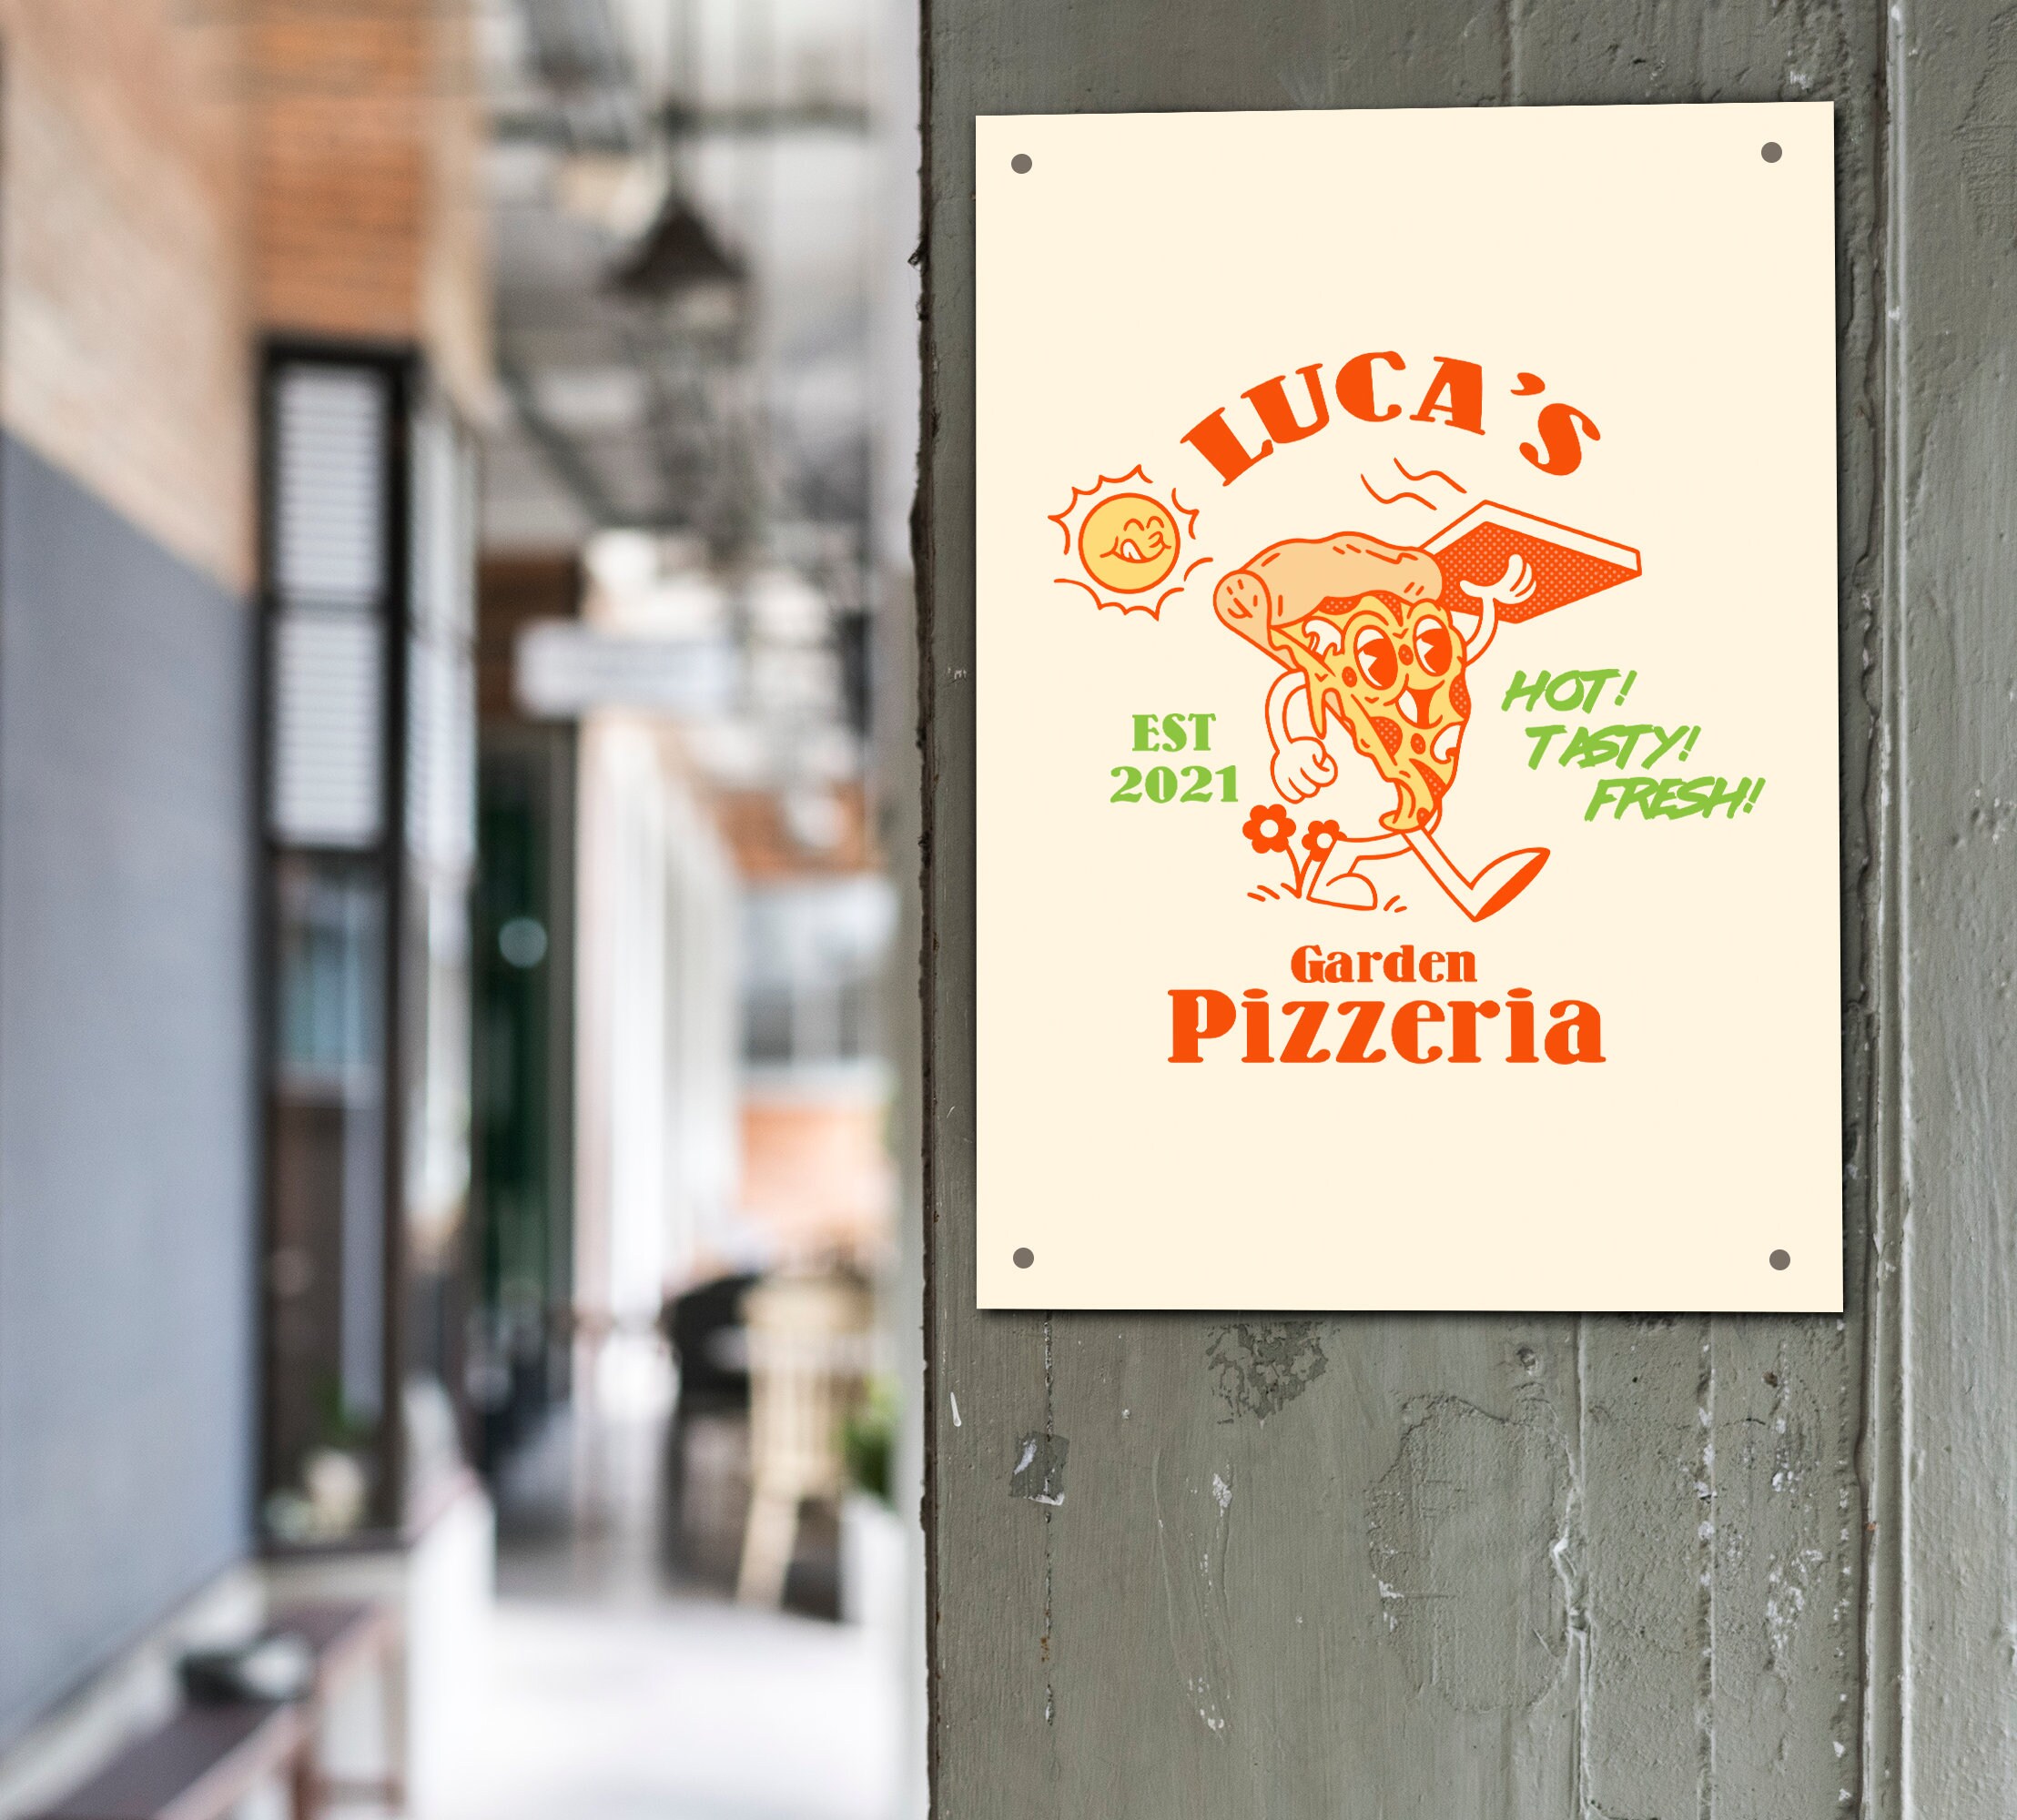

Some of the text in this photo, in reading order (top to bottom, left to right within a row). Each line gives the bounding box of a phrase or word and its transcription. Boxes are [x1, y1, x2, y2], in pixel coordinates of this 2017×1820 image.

[1181, 351, 1600, 487] LUCA'S
[1502, 669, 1637, 713] HOT!
[1132, 713, 1216, 752] EST
[1525, 724, 1701, 770] TASTY!
[1110, 765, 1238, 804] 2021
[1584, 776, 1766, 822] FRESH!
[1291, 945, 1477, 983] Garden
[1168, 987, 1606, 1065] Pizzeria
